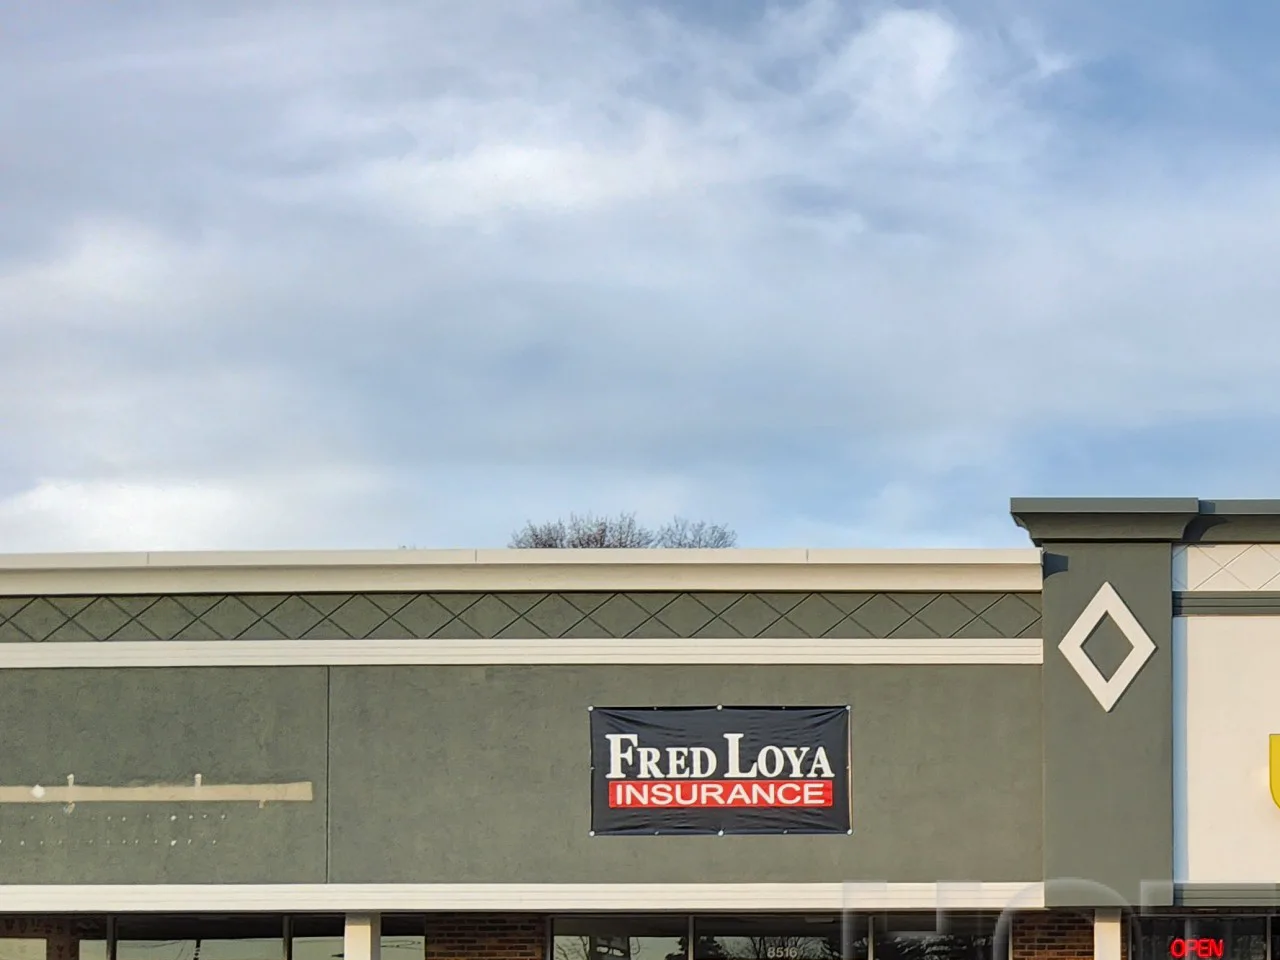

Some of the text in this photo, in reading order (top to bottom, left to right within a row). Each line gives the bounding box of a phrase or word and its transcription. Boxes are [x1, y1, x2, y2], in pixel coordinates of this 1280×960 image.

[605, 732, 836, 779] FRED LOYA
[615, 782, 825, 805] INSURANCE
[767, 946, 798, 959] 8516
[1170, 938, 1224, 959] OPEN
